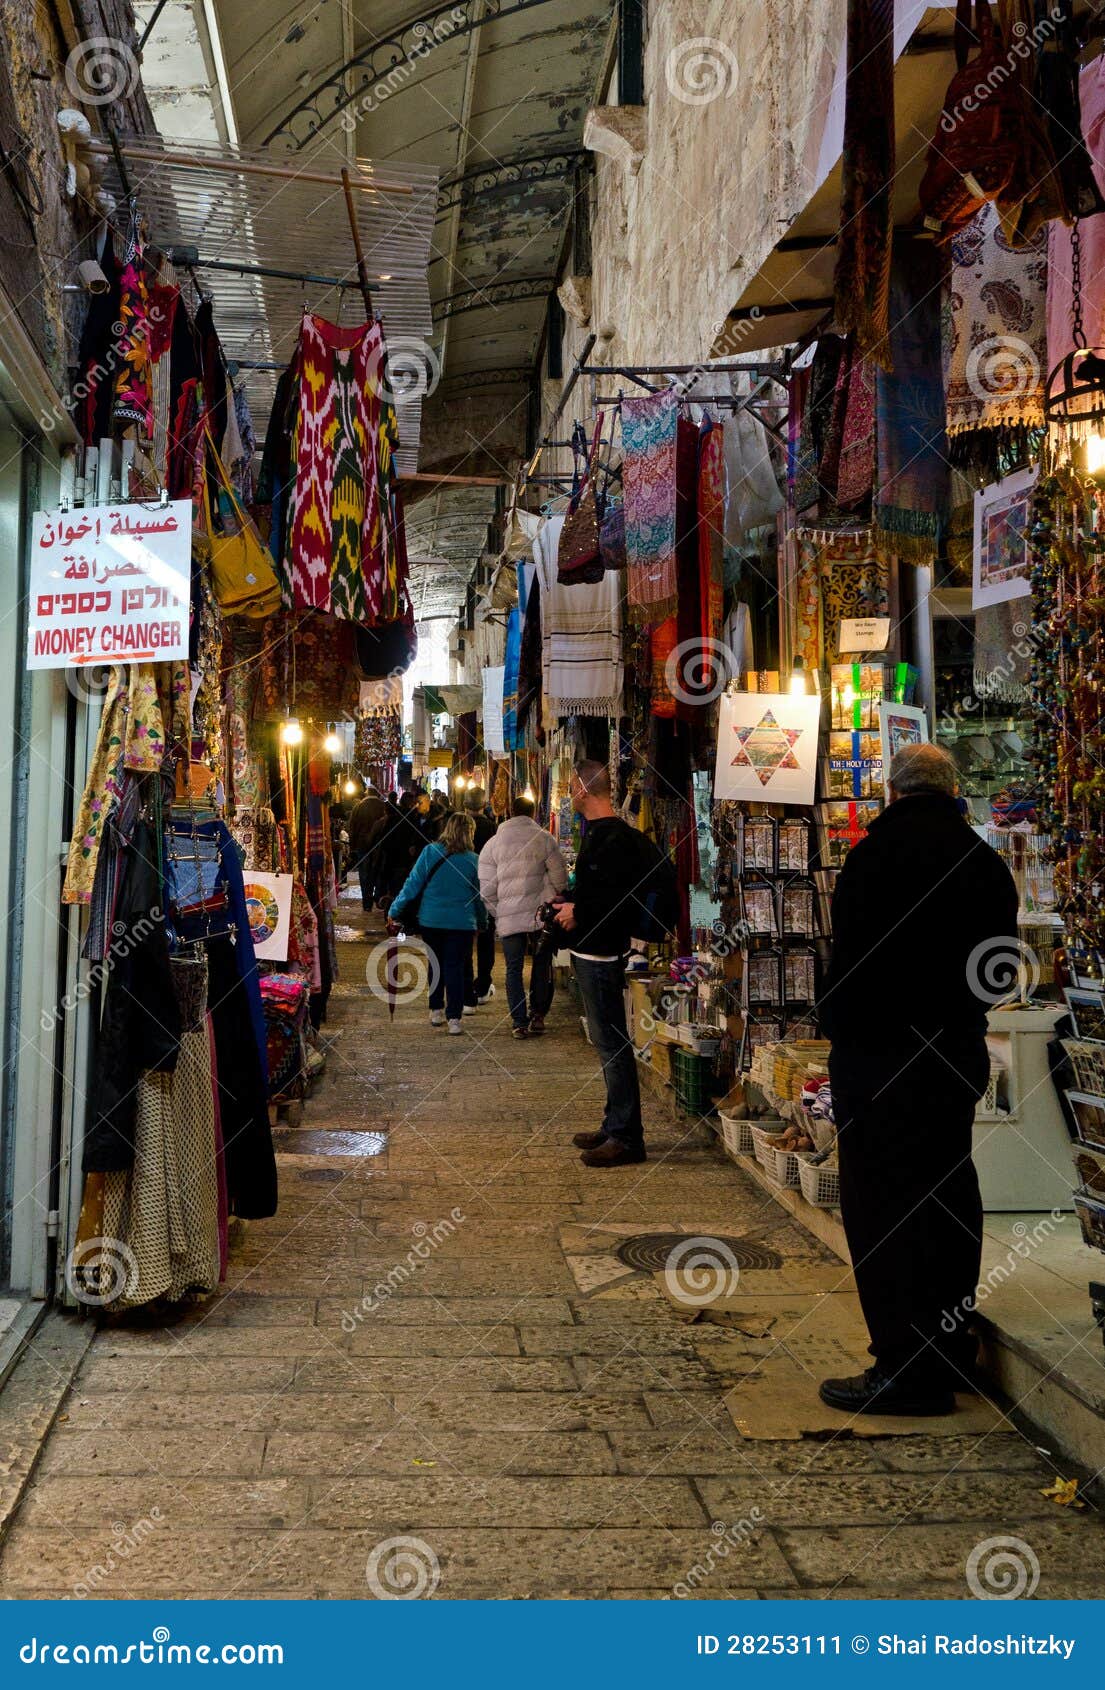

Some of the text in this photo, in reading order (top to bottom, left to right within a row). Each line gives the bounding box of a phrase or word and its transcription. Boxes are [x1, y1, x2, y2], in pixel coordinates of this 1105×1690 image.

[37, 590, 111, 617] כספים
[34, 620, 181, 656] MONEY CHANGER
[831, 760, 883, 768] THE HOLY LAND
